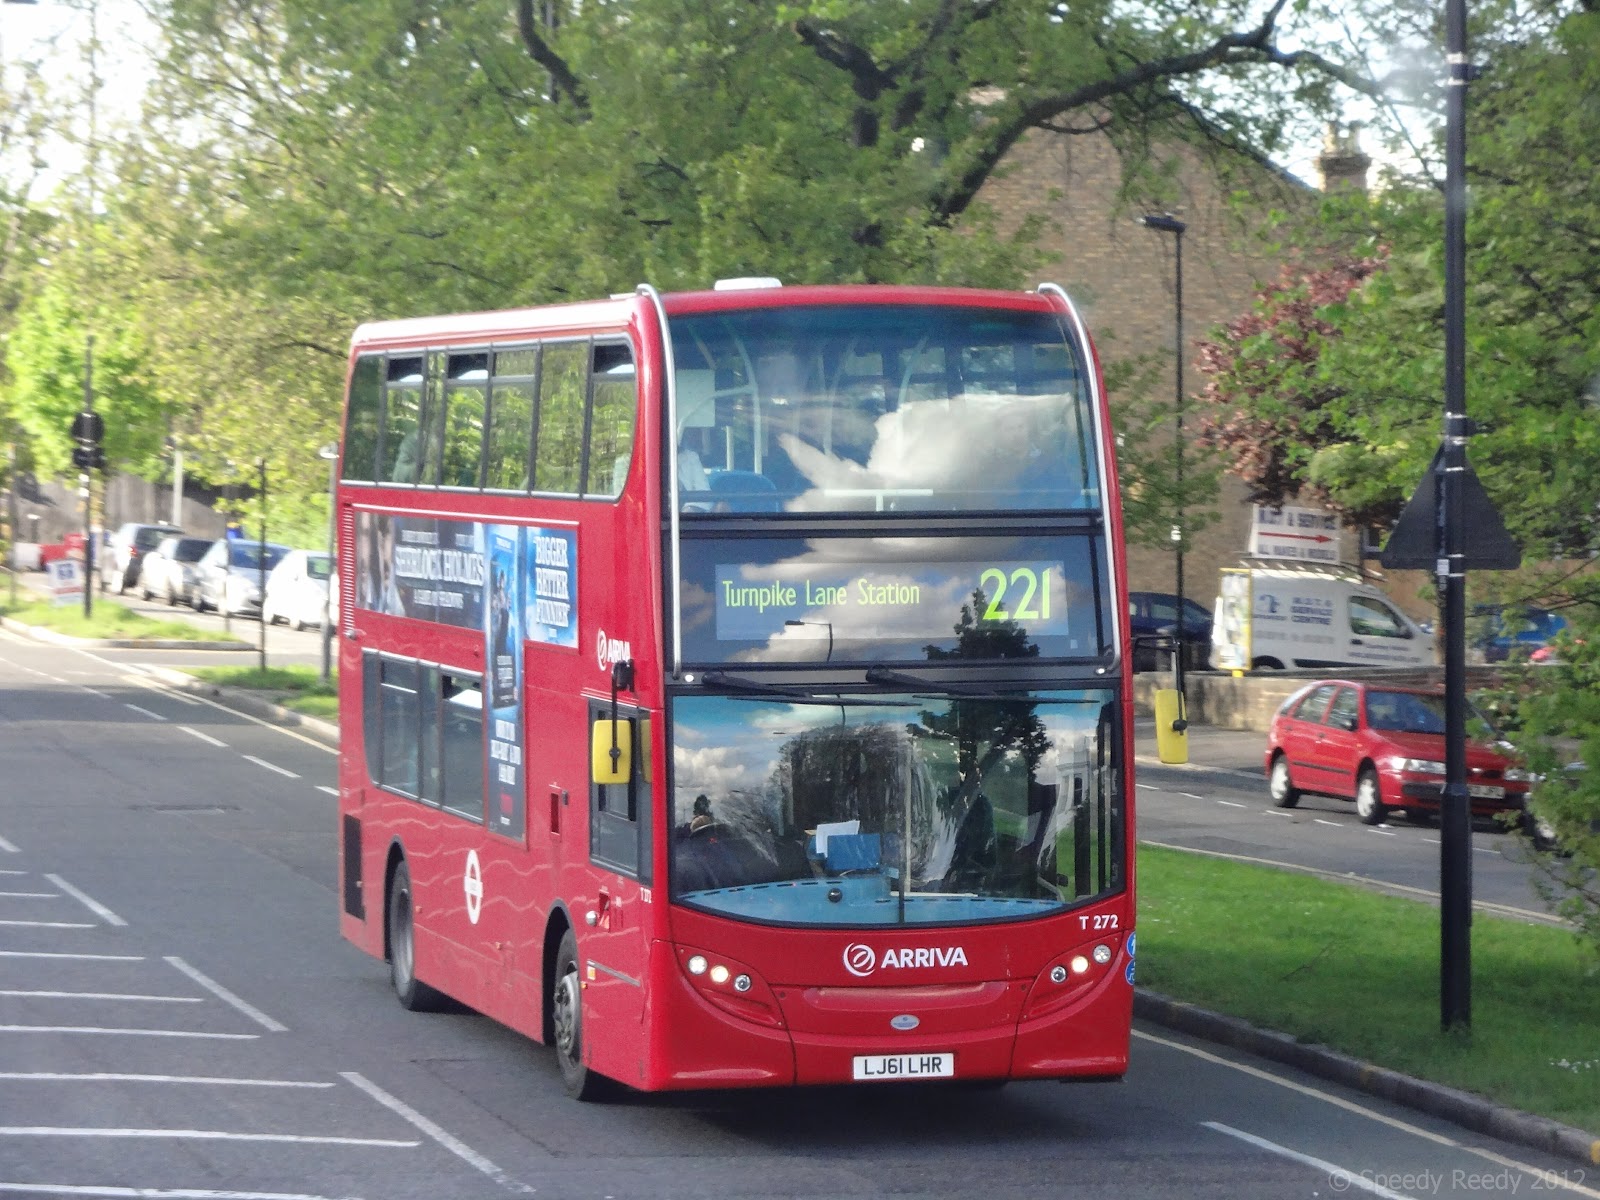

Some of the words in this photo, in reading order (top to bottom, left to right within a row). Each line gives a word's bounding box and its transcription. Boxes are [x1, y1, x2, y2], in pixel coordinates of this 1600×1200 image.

[722, 580, 796, 613] Turnpike
[806, 579, 847, 606] Lane
[857, 578, 920, 605] Station
[981, 567, 1051, 620] 221
[1079, 915, 1090, 930] T
[1093, 914, 1119, 929] 272
[881, 946, 968, 968] ARRIVA
[864, 1059, 903, 1076] LJ61
[908, 1057, 942, 1074] LHR
